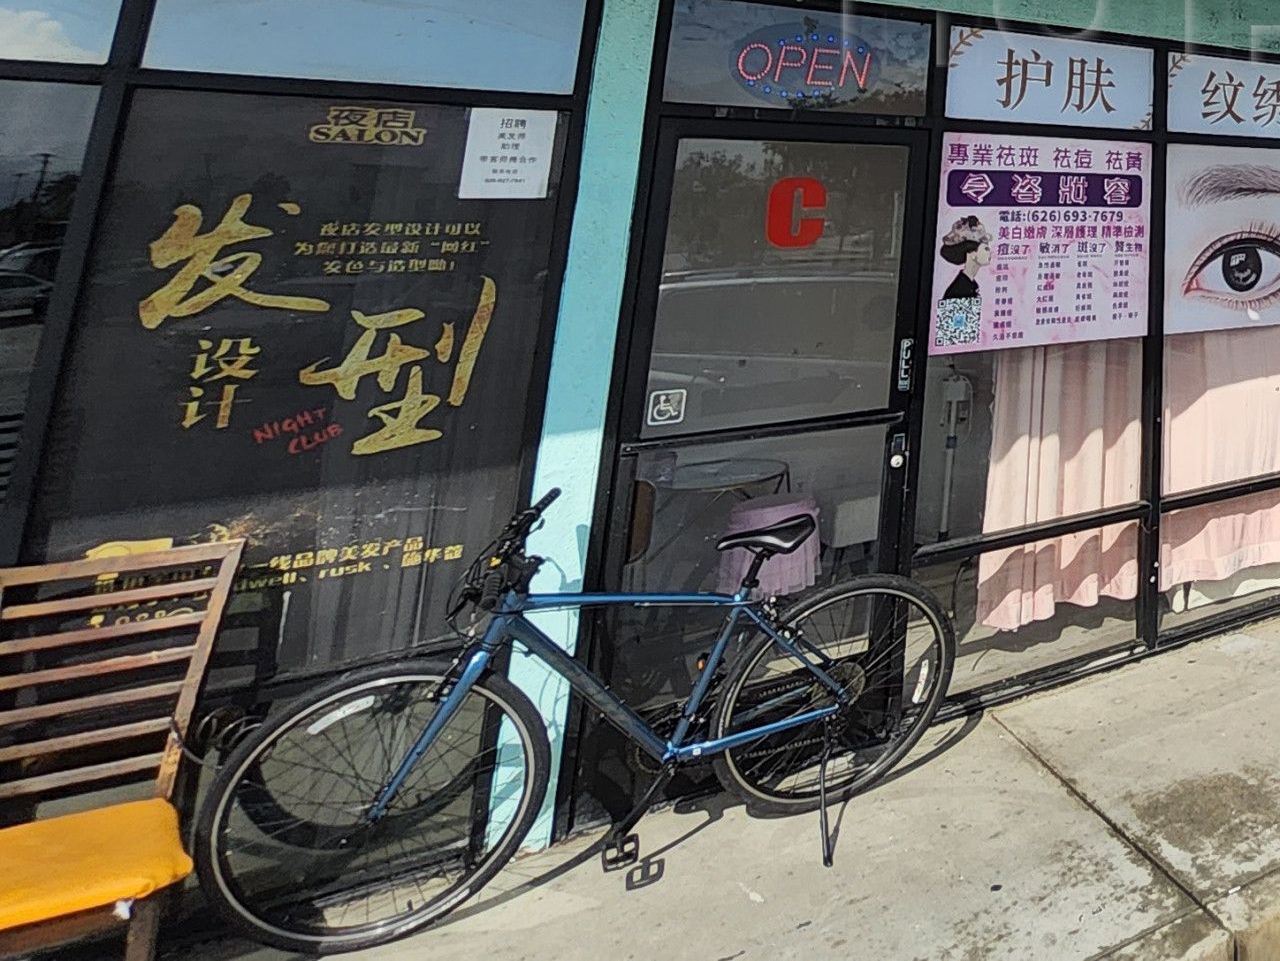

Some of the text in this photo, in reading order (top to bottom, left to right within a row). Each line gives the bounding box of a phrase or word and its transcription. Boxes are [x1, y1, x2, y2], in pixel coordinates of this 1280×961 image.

[736, 42, 872, 89] OPEN
[995, 48, 1117, 114] 护肤
[311, 126, 425, 144] SALON
[328, 107, 413, 129] 夜店
[947, 143, 1143, 171] 專業祛斑 祛痘 祛黃
[765, 176, 828, 249] C
[901, 340, 912, 378] PULL
[179, 337, 261, 430] 设计
[252, 407, 327, 444] NIGHT
[287, 423, 344, 454] CLUB
[240, 536, 424, 572] 一线品牌美发产品
